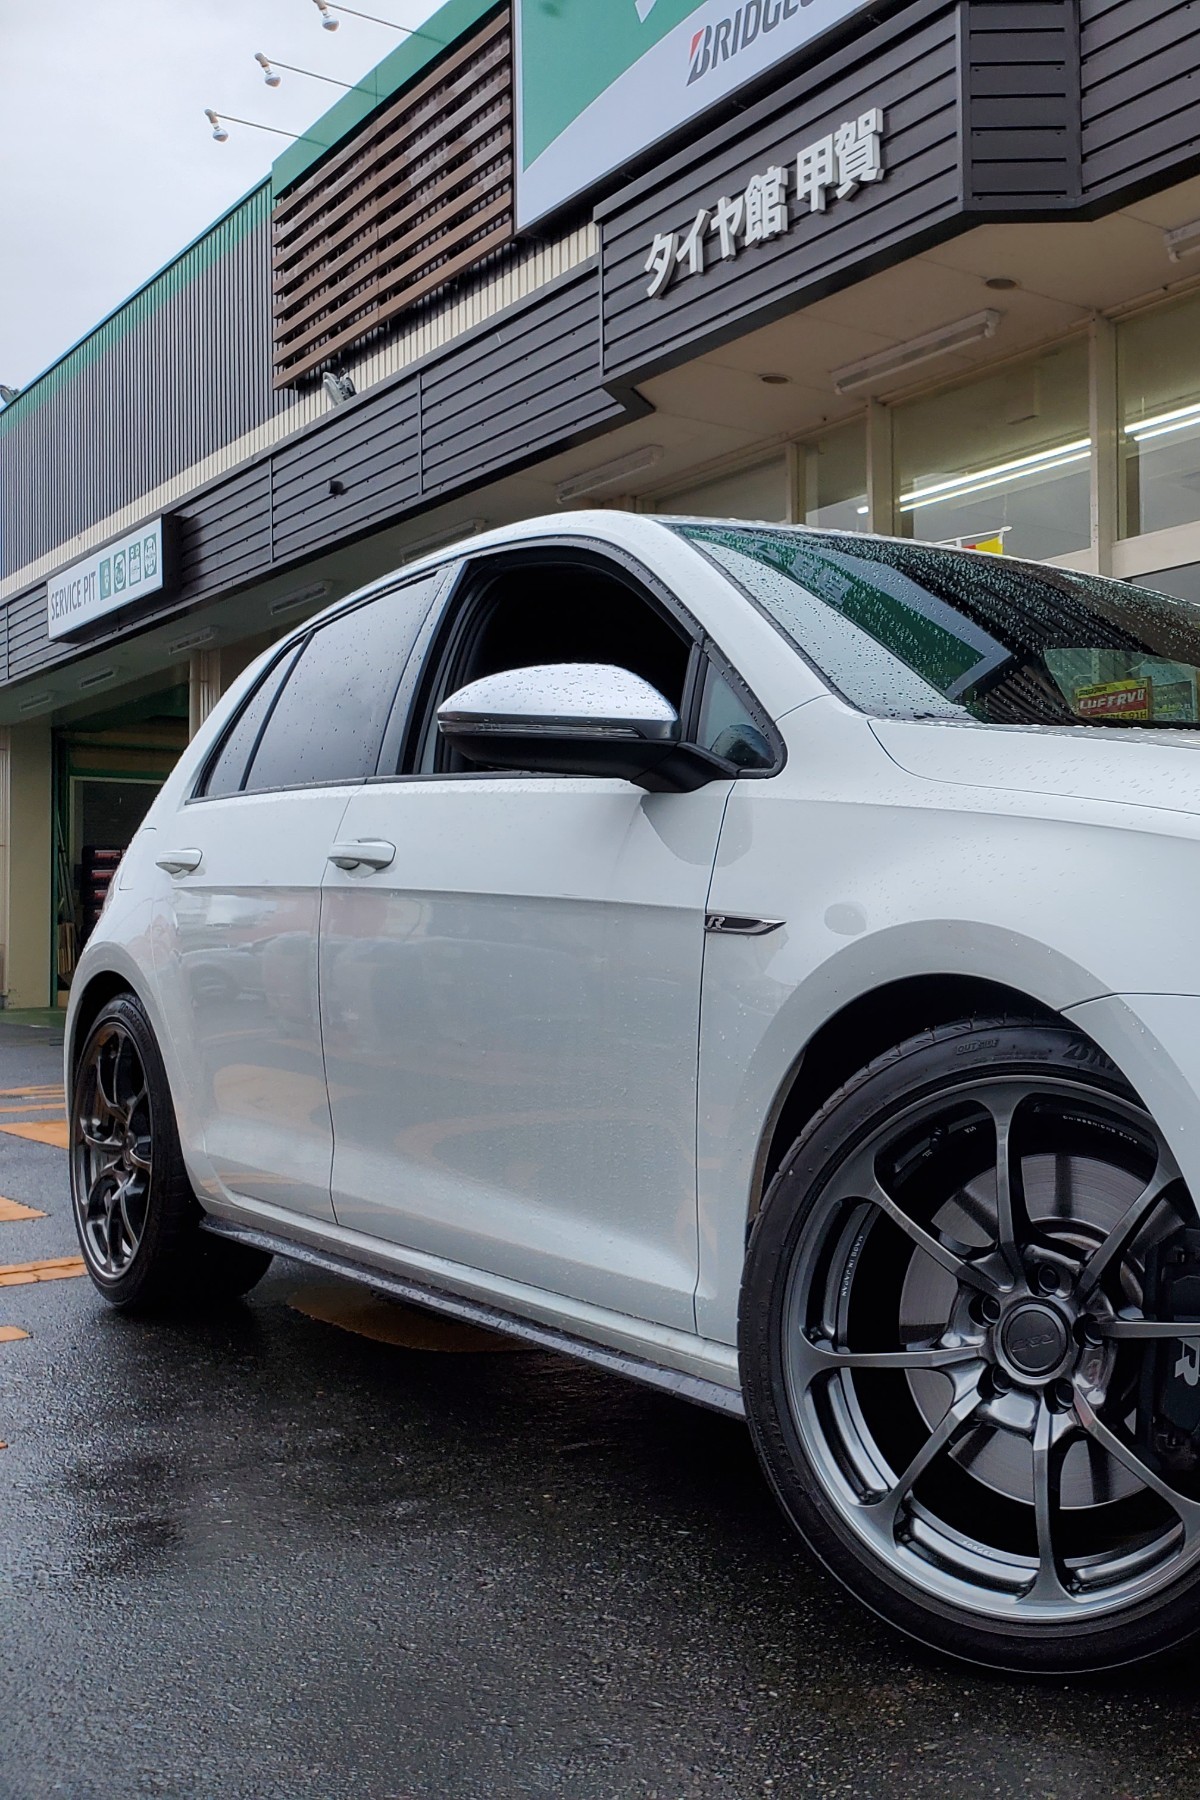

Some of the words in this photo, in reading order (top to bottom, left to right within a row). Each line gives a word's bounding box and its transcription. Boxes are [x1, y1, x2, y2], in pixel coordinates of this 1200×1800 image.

[686, 0, 815, 87] BRIDG
[644, 165, 788, 299] タイヤ館
[797, 107, 884, 213] 甲賀
[51, 579, 82, 621] SERVICE
[83, 570, 96, 606] PIT
[706, 916, 726, 929] R
[850, 1235, 864, 1257] MADE
[848, 1260, 855, 1268] IN
[841, 1269, 852, 1297] JAPAN
